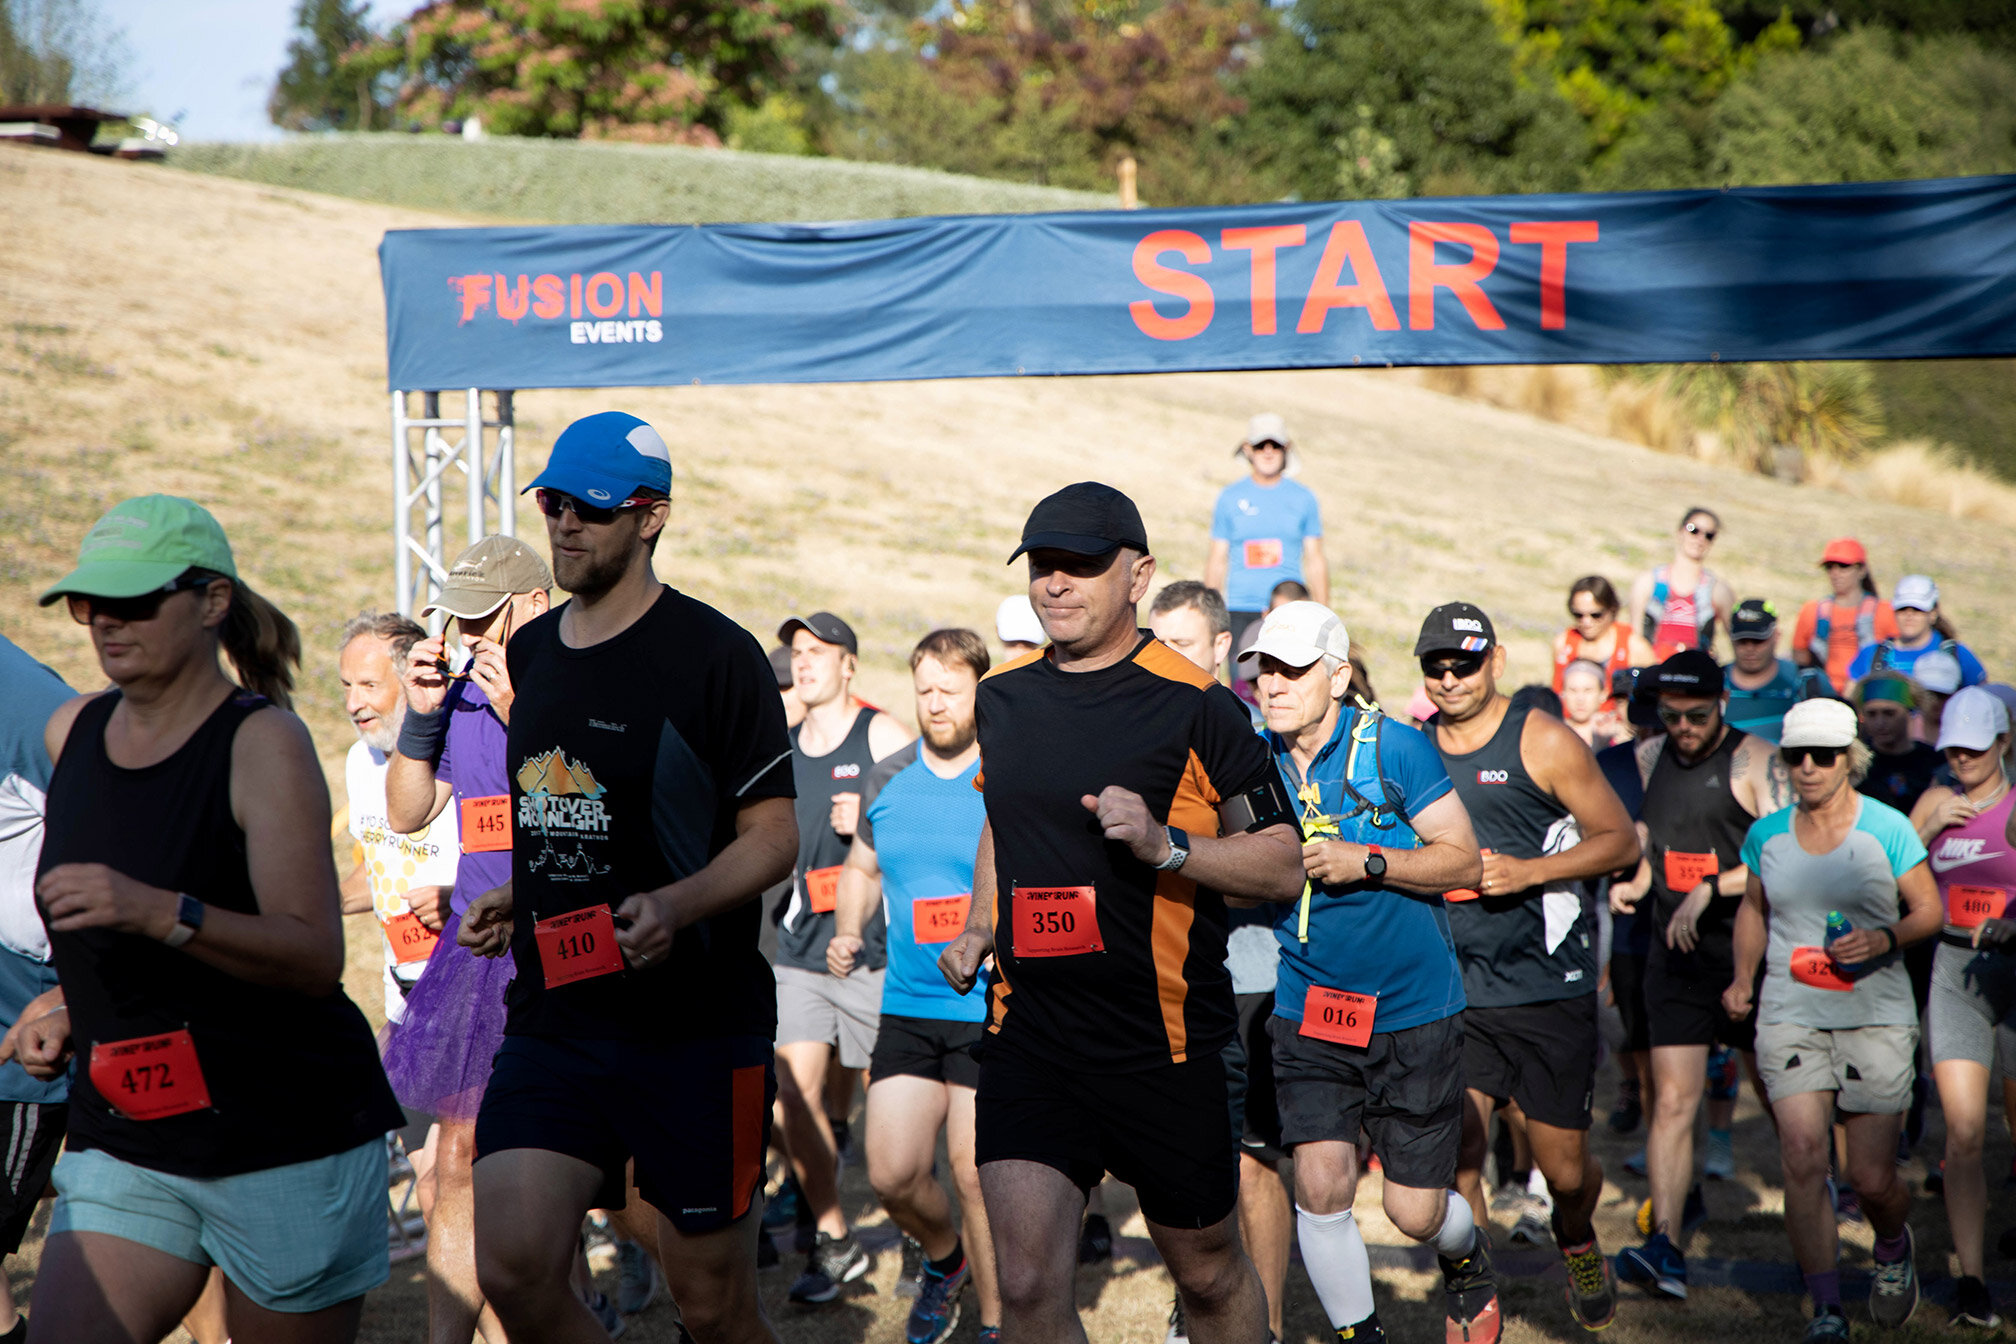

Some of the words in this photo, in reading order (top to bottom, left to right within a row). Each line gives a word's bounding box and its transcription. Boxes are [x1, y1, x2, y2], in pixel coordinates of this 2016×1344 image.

[1129, 220, 1599, 341] START
[449, 271, 663, 324] FUSION
[570, 320, 663, 344] EVENTS
[1480, 769, 1509, 783] BDO
[519, 796, 605, 817] SHOTOVER
[477, 814, 504, 832] 445
[1940, 837, 1986, 858] NIKE
[1963, 900, 1991, 913] 480
[929, 911, 960, 928] 452
[1033, 911, 1075, 933] 350
[403, 926, 432, 945] 632
[557, 932, 595, 960] 410
[1323, 1006, 1357, 1028] 016
[122, 1063, 174, 1093] 472
